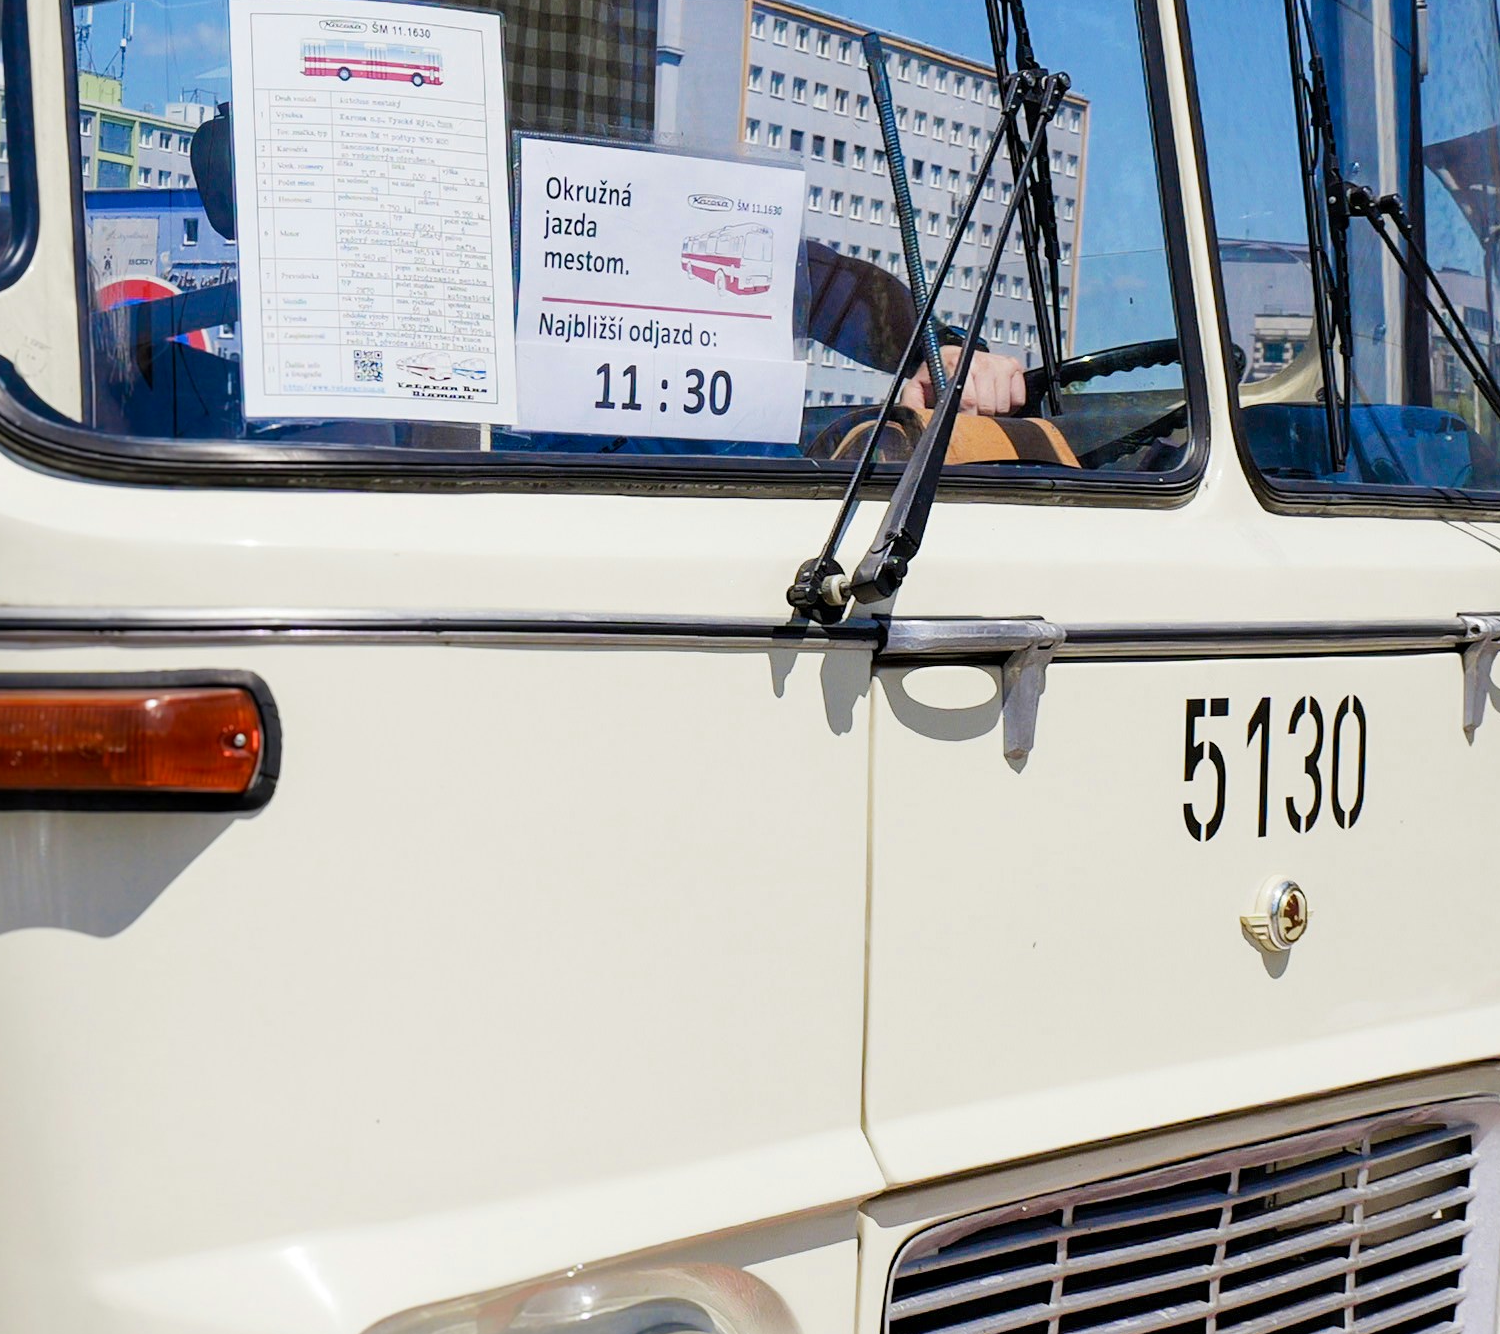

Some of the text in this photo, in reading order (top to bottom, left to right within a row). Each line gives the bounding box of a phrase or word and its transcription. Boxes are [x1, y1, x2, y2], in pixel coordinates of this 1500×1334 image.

[372, 22, 388, 34] ŠM
[393, 26, 431, 39] 11.1630
[546, 176, 632, 207] Okružná
[692, 196, 783, 216] Karosa ŠM 11.1630
[544, 210, 597, 239] jazda
[544, 250, 630, 275] mestom.
[539, 312, 717, 349] Najbližší odjazd o:
[1183, 694, 1367, 843] 5130
